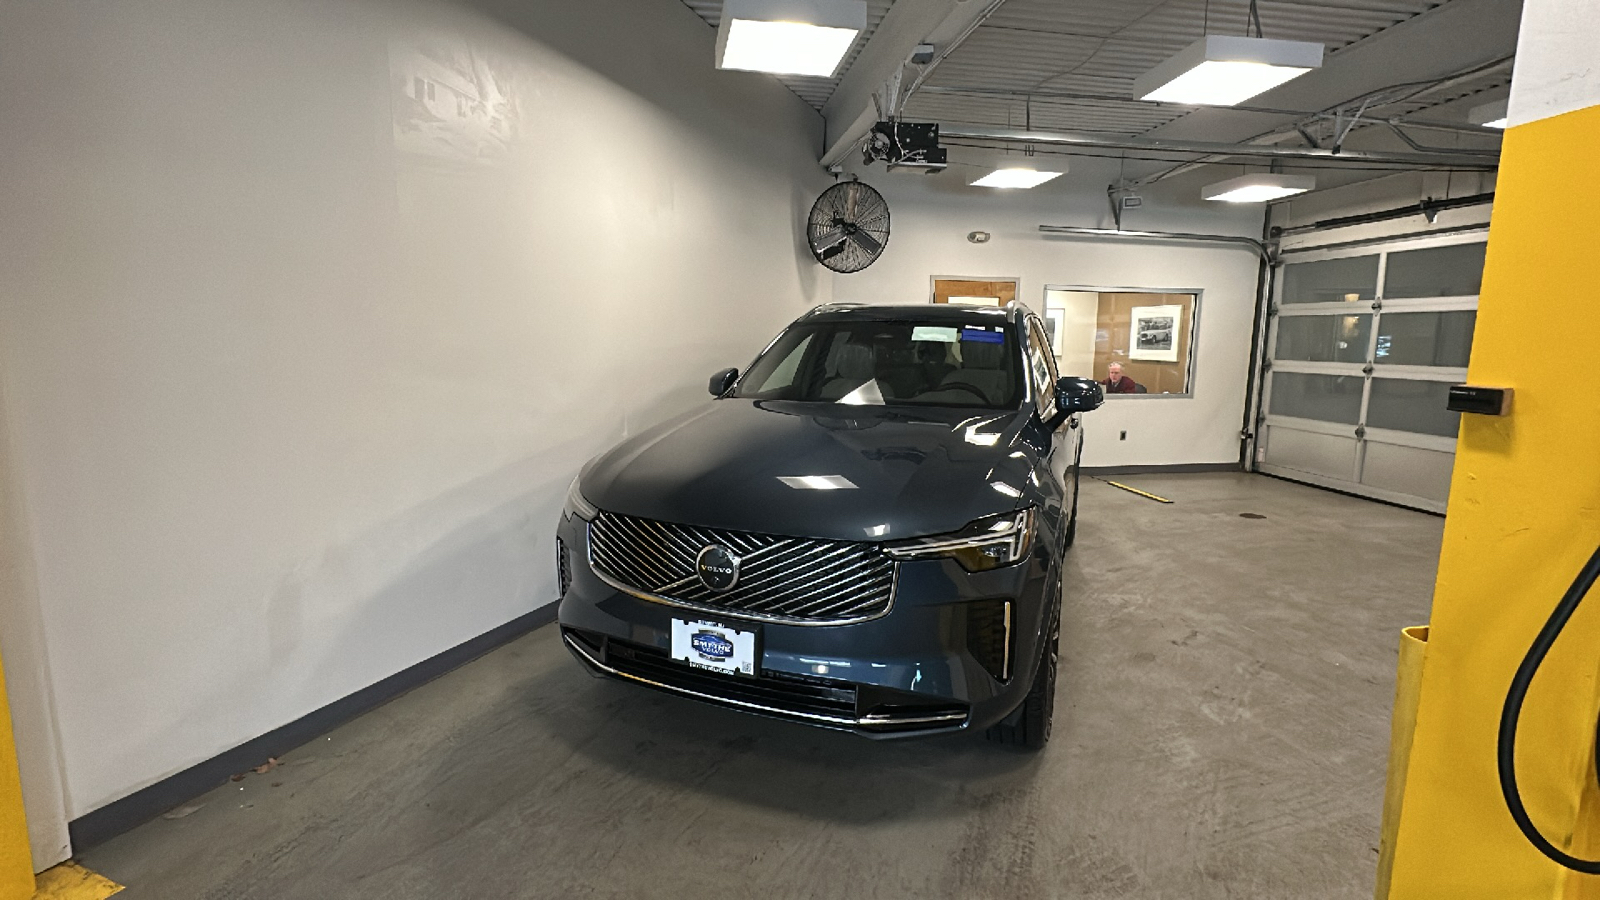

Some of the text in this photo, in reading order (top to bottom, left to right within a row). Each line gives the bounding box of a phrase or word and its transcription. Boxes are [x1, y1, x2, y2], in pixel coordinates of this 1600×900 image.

[701, 564, 733, 574] VOLVO
[693, 639, 732, 652] SMYTHE
[702, 646, 724, 655] VOLVO
